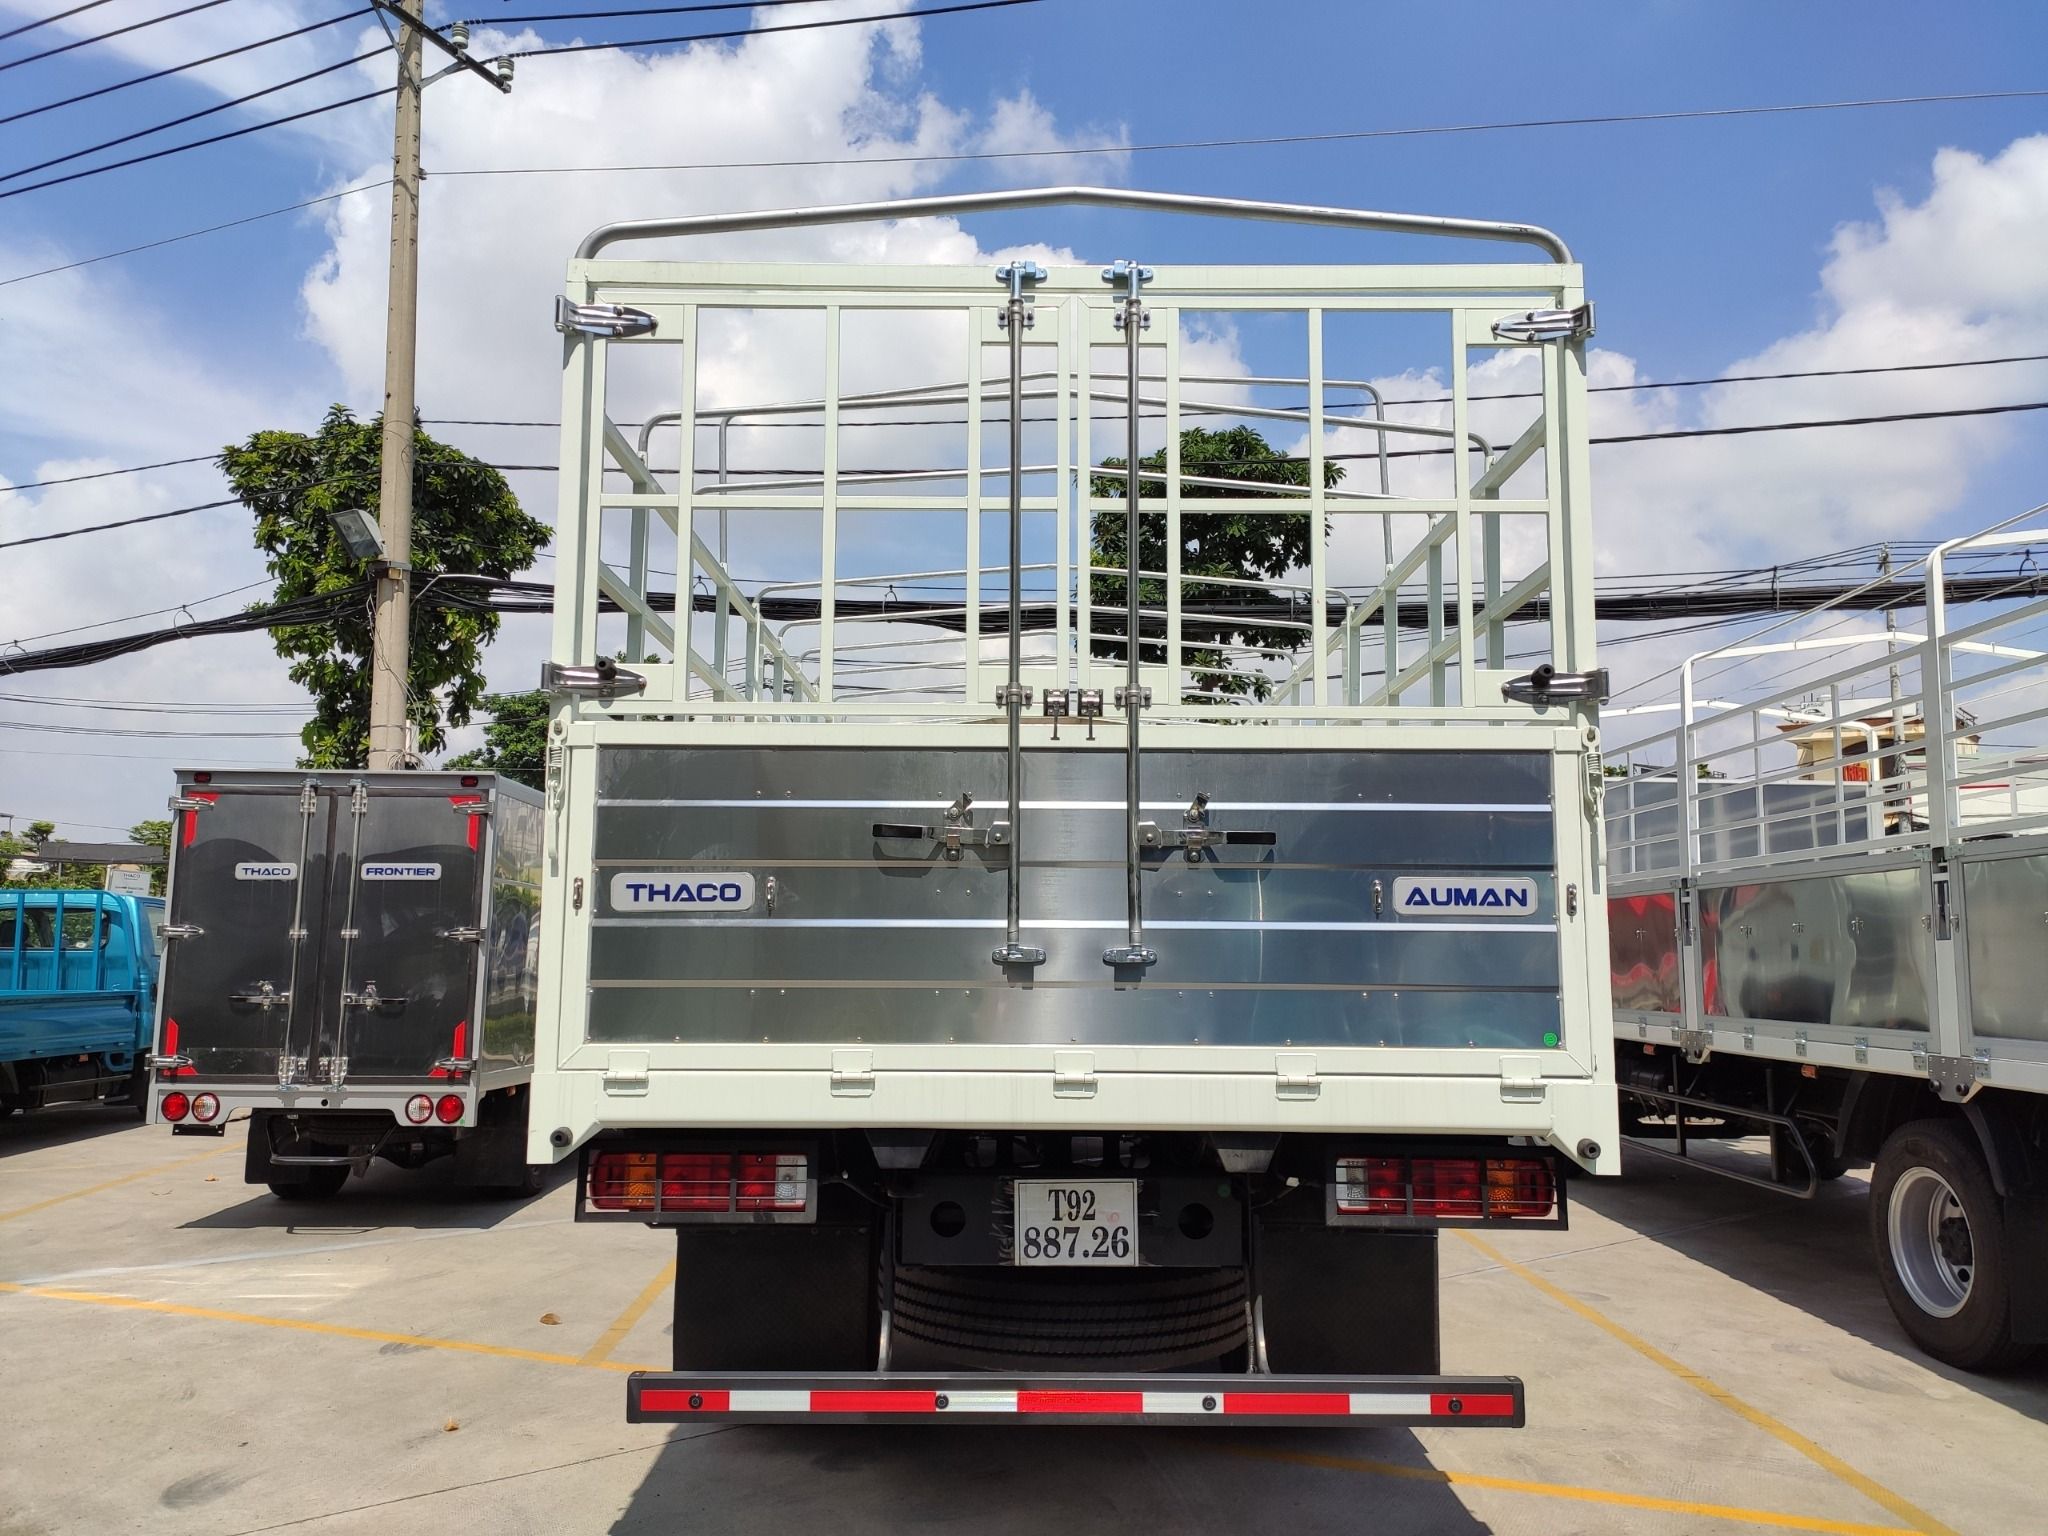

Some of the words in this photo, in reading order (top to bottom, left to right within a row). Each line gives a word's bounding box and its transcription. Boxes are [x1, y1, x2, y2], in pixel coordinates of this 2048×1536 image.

[241, 867, 291, 876] THACO
[365, 867, 436, 876] FRONTIER
[625, 883, 742, 902] THACO
[1404, 886, 1528, 907] AUMAN
[1048, 1189, 1096, 1222] T92
[1023, 1226, 1130, 1259] 887.26
